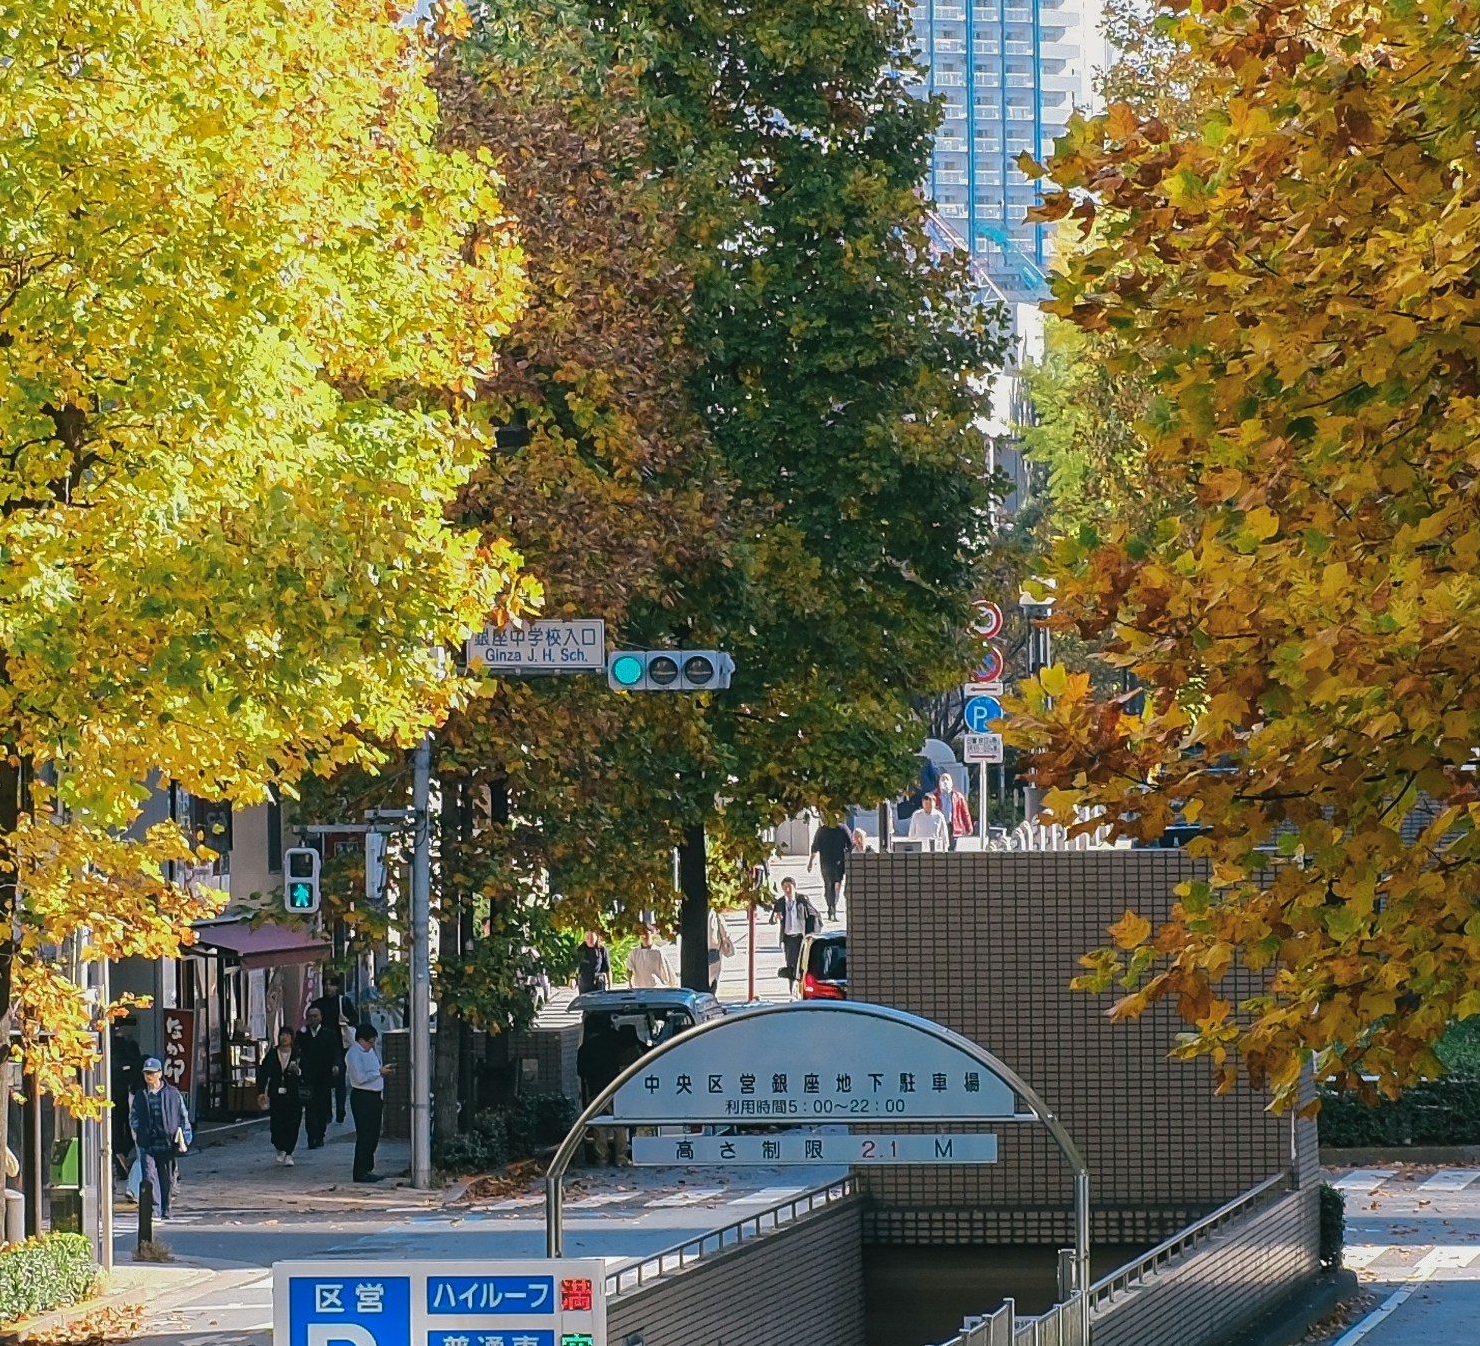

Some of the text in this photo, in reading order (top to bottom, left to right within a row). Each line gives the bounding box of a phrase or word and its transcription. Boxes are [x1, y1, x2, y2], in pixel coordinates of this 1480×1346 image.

[474, 627, 596, 647] 銀座中学校入口
[485, 647, 589, 663] Ginza J. H. Sch.
[643, 1072, 982, 1095] 中央区営銀座地下駐車場
[675, 1140, 954, 1161] 高さ制限 2.1 M
[314, 1282, 385, 1314] 区営
[432, 1282, 549, 1309] ハイルーフ
